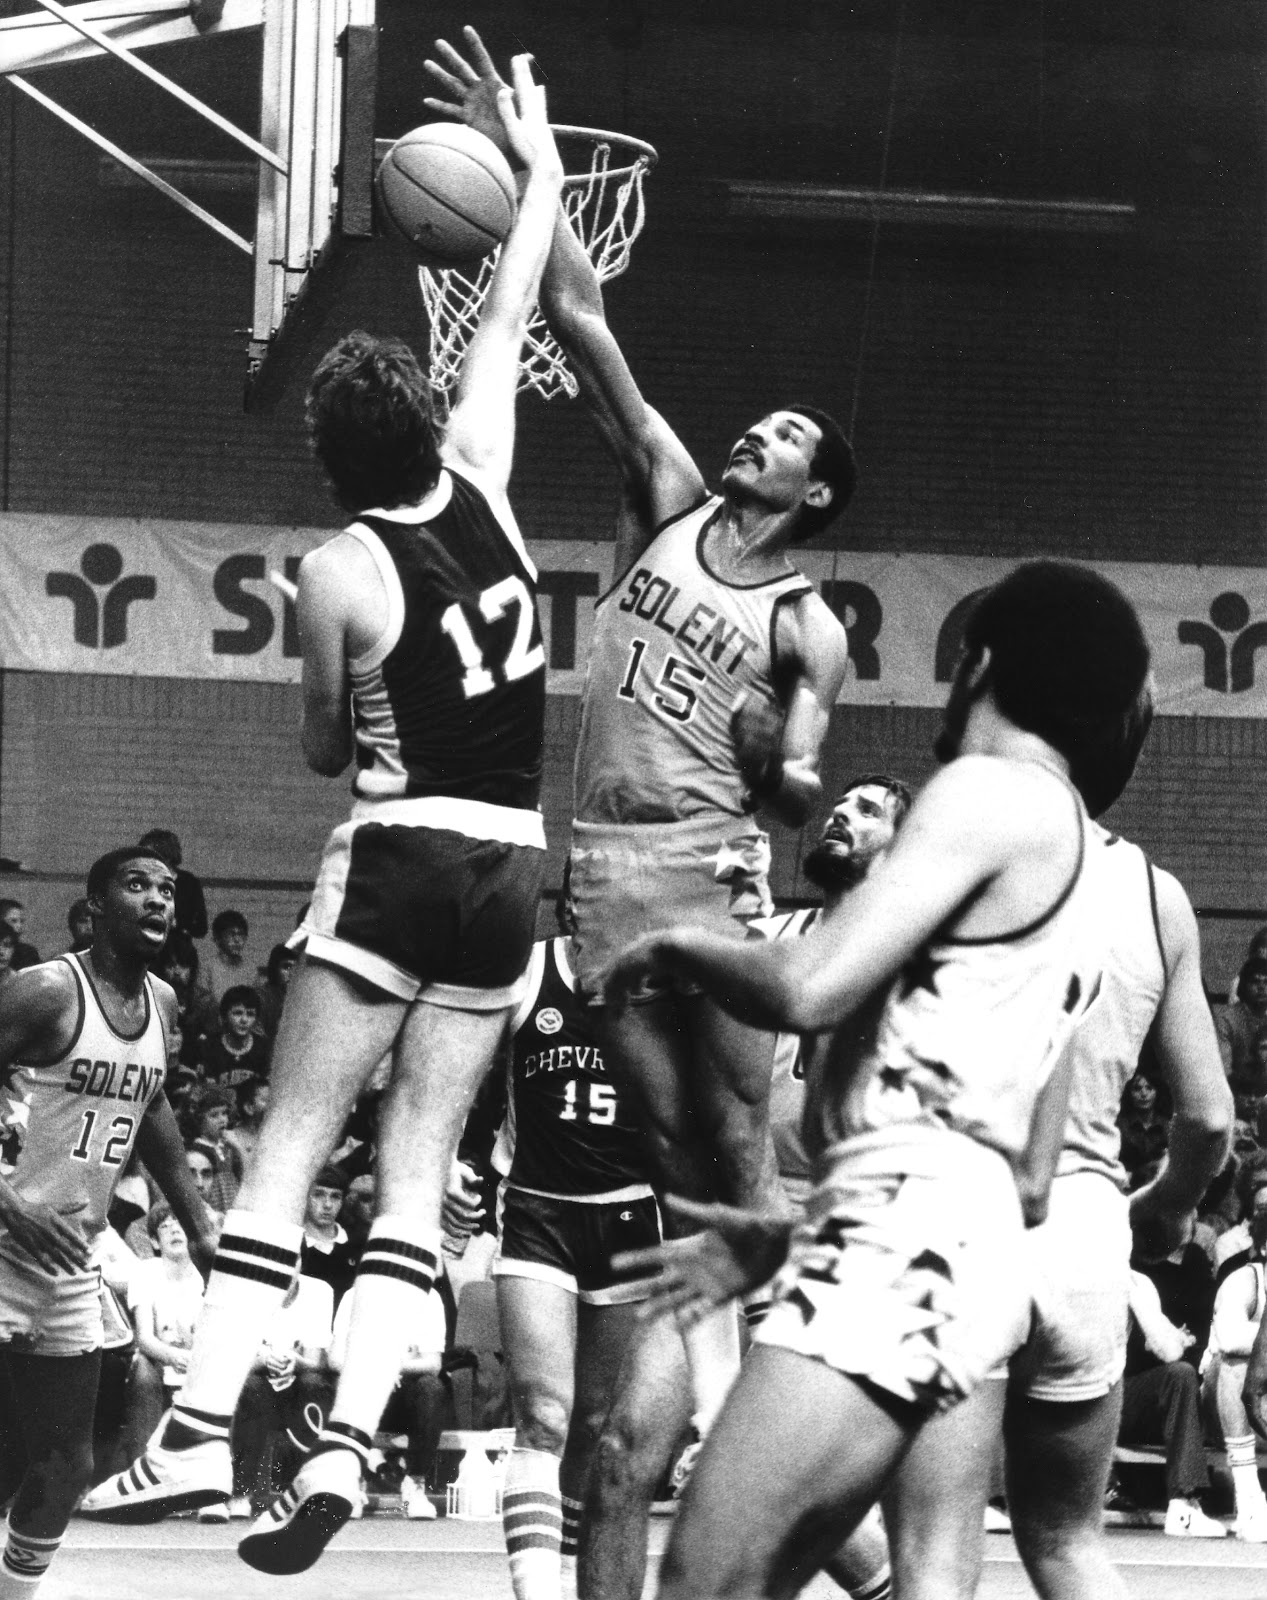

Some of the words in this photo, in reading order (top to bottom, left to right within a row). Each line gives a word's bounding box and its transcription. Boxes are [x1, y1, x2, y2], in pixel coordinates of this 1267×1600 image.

[441, 575, 545, 699] 12
[620, 568, 758, 675] SOLENT
[617, 636, 706, 723] 15
[65, 1058, 163, 1102] SOLENT
[559, 1080, 617, 1125] 15
[70, 1109, 134, 1168] 12
